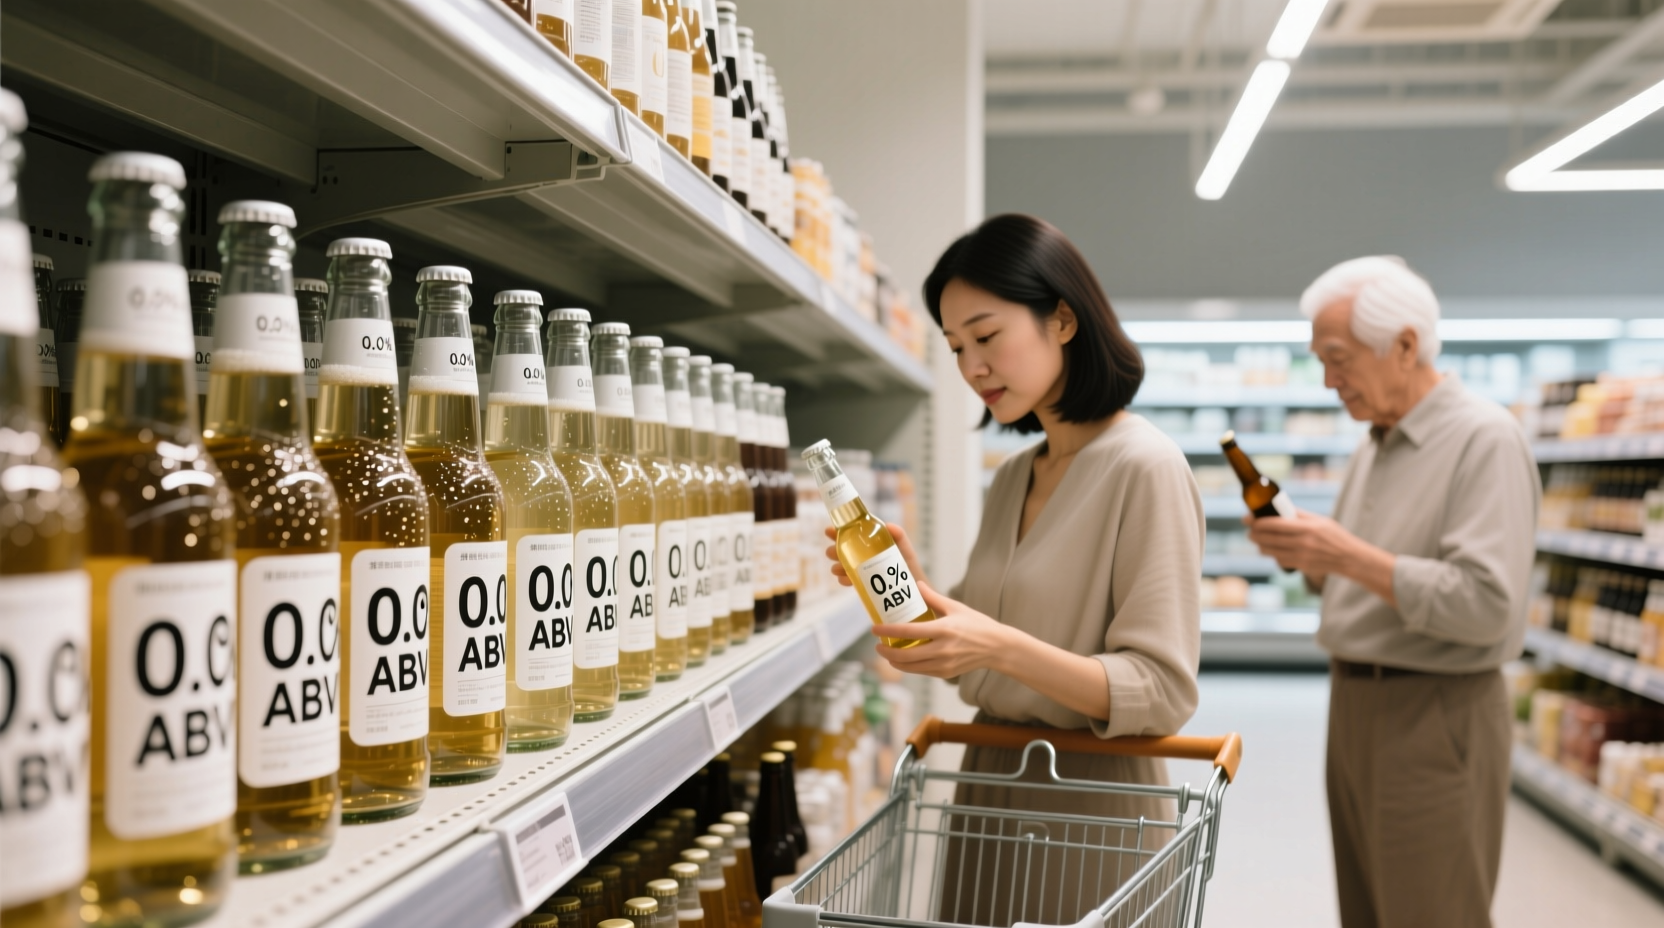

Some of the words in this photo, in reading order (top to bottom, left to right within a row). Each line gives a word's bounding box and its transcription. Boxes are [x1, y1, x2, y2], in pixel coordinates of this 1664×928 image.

[870, 562, 908, 596] 0.%
[883, 584, 911, 612] ABV
[585, 604, 618, 633] AB
[366, 649, 428, 696] ABV
[262, 672, 338, 728] ABV
